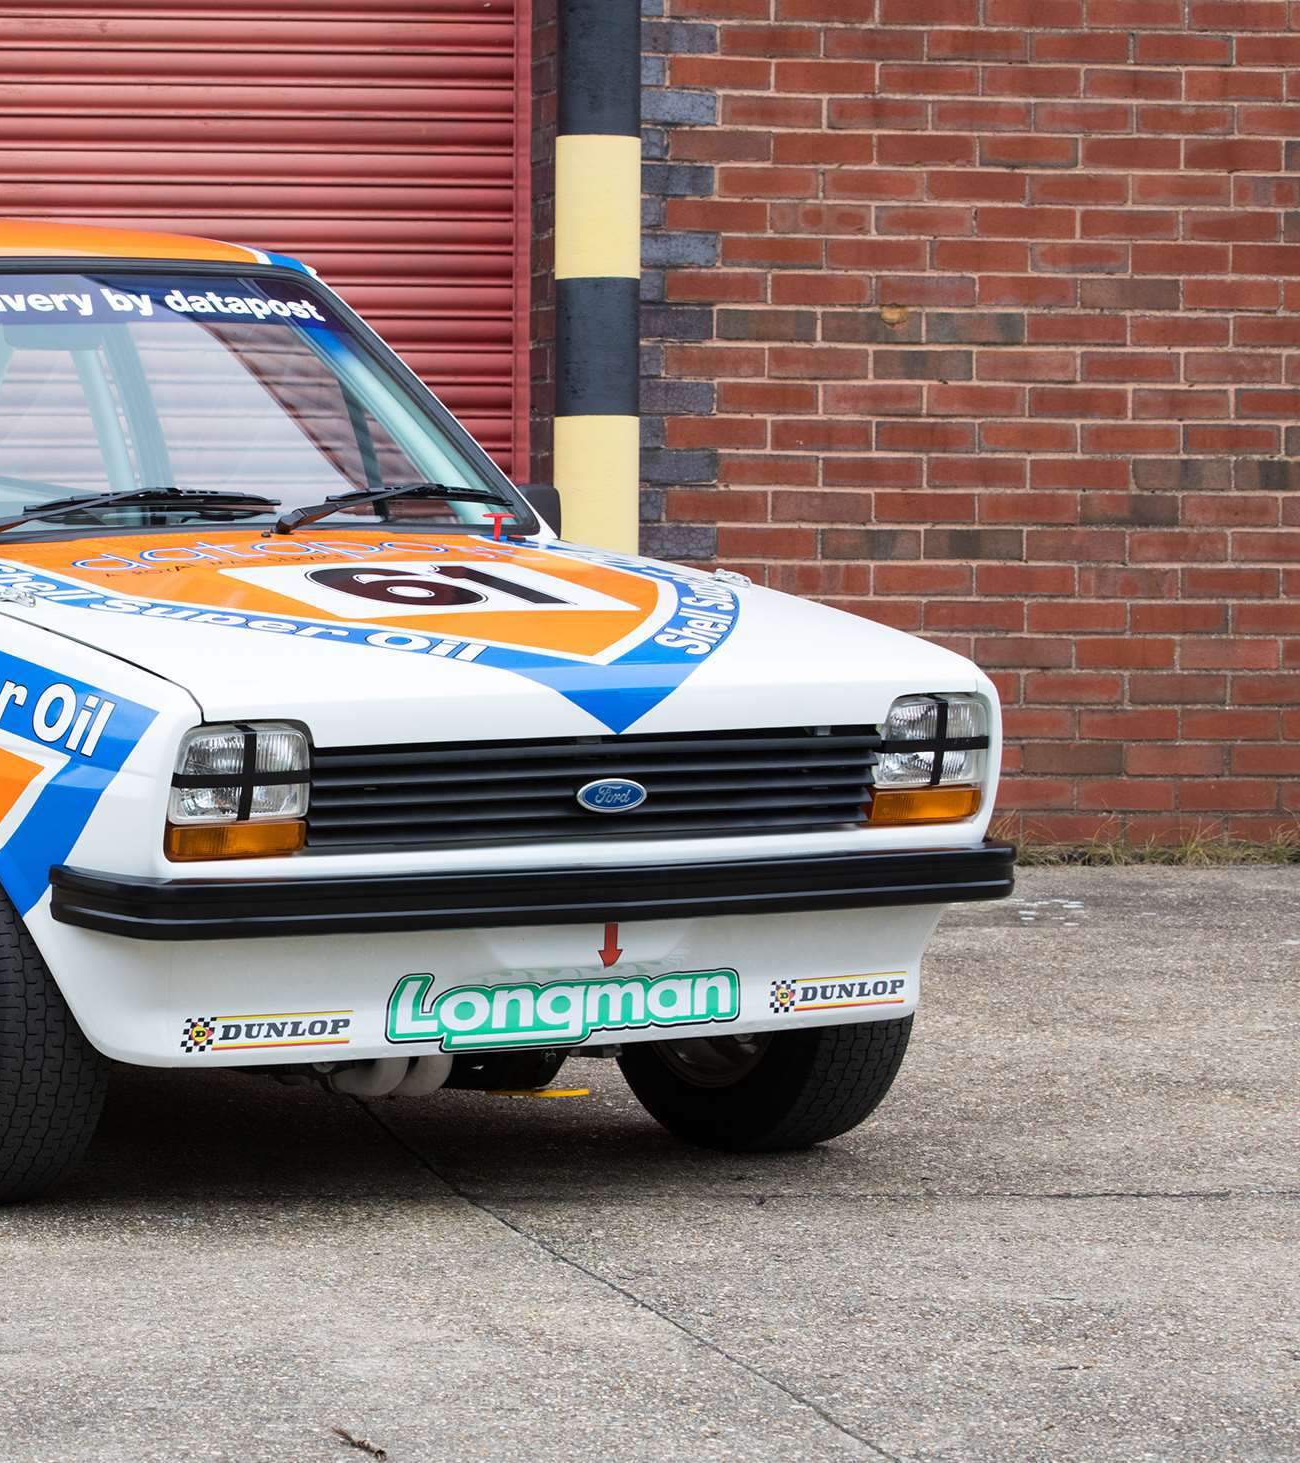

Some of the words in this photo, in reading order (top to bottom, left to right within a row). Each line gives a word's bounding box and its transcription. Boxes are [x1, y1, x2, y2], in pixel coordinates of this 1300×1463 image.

[99, 288, 154, 317] by
[163, 288, 326, 323] datapost
[304, 565, 578, 606] 61
[88, 598, 350, 638] Super
[364, 630, 490, 662] Oil
[653, 607, 736, 656] Shell
[32, 682, 116, 758] Oil
[595, 785, 632, 804] Ford
[393, 974, 733, 1046] Longman
[799, 979, 905, 1002] DUNLOP
[194, 1030, 206, 1038] D
[219, 1018, 350, 1041] DUNLOP
